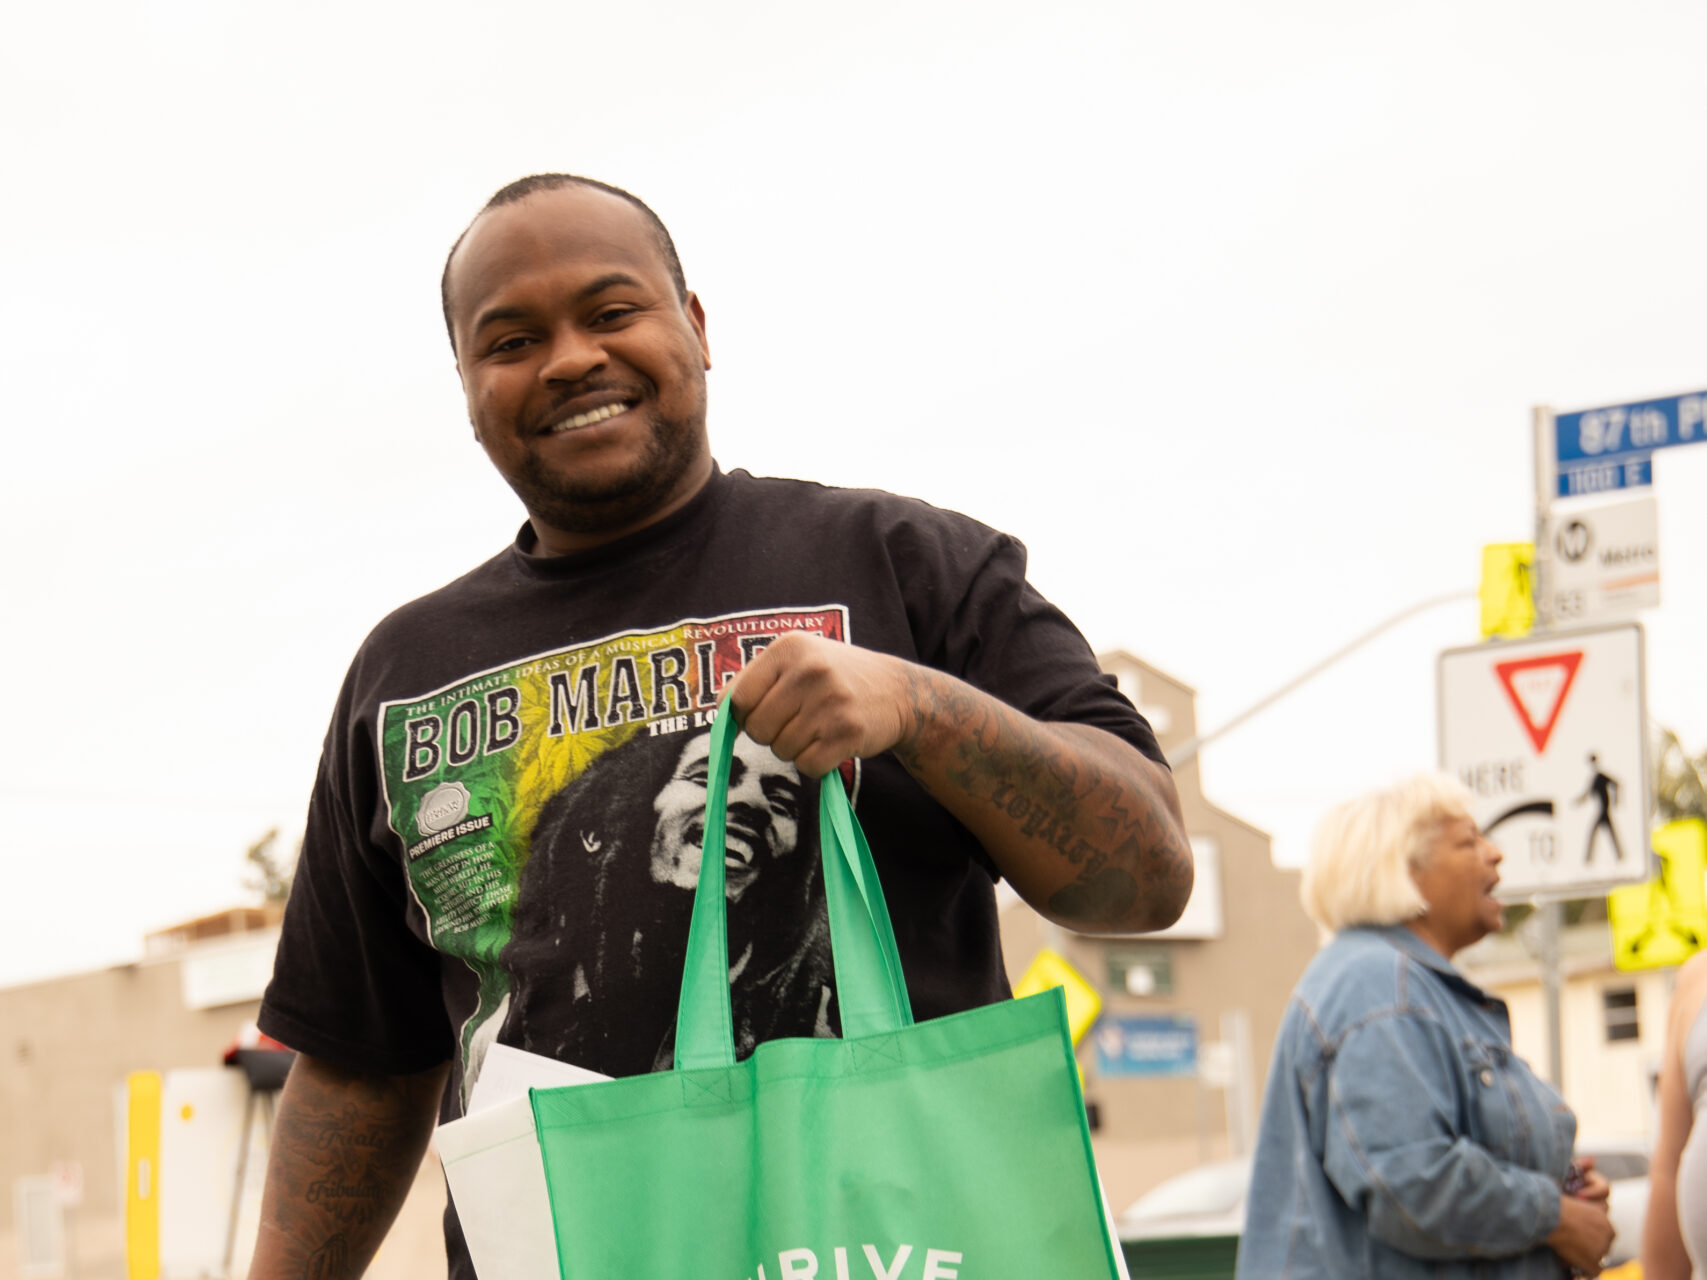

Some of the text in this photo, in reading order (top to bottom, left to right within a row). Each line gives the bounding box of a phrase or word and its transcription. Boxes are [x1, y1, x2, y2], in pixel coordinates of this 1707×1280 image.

[1579, 406, 1667, 454] 87th
[1625, 458, 1642, 486] E
[405, 615, 825, 717] THE INTIMATE IDEAS OF A MUSICAL REVOLUTIONARY
[403, 630, 823, 782] BOB MARL
[647, 715, 688, 737] THE
[408, 816, 490, 860] PREMIERE ISSUE
[433, 848, 473, 872] GREATNESS
[474, 843, 486, 853] OF
[444, 863, 460, 876] NOT
[461, 859, 471, 868] IN
[472, 850, 494, 864] HOW
[465, 886, 483, 897] AND
[485, 880, 500, 890] HIS
[473, 875, 484, 884] IN
[486, 869, 502, 880] HIS
